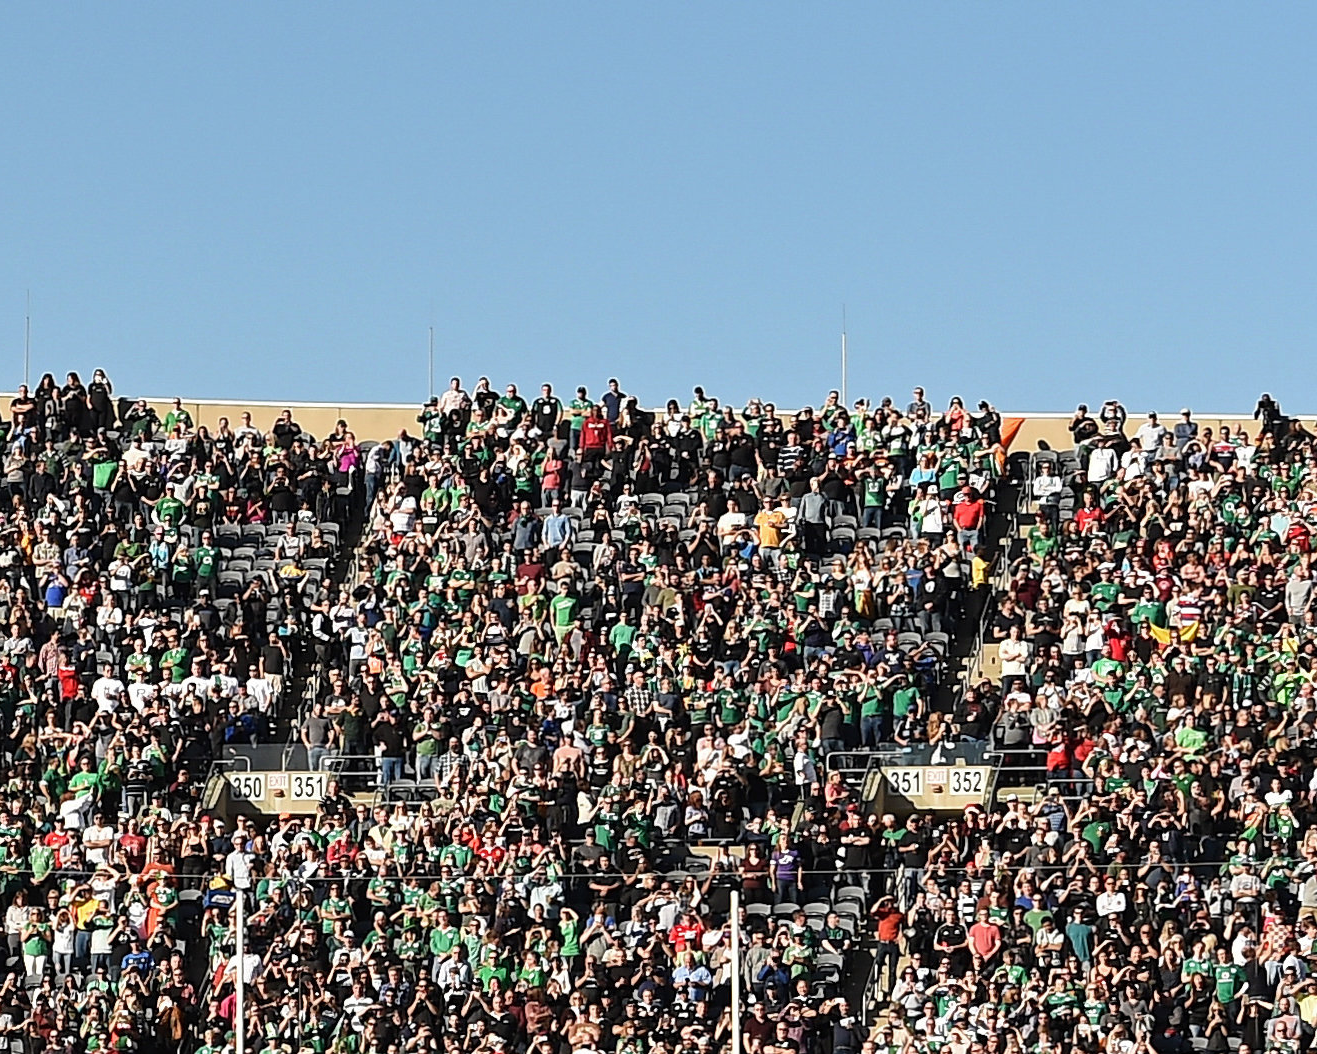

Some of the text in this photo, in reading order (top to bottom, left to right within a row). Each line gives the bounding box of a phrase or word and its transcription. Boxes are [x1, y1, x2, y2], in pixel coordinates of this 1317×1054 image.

[233, 775, 324, 799] 350 EXIT 351
[890, 770, 982, 793] 351 EXIT 352
